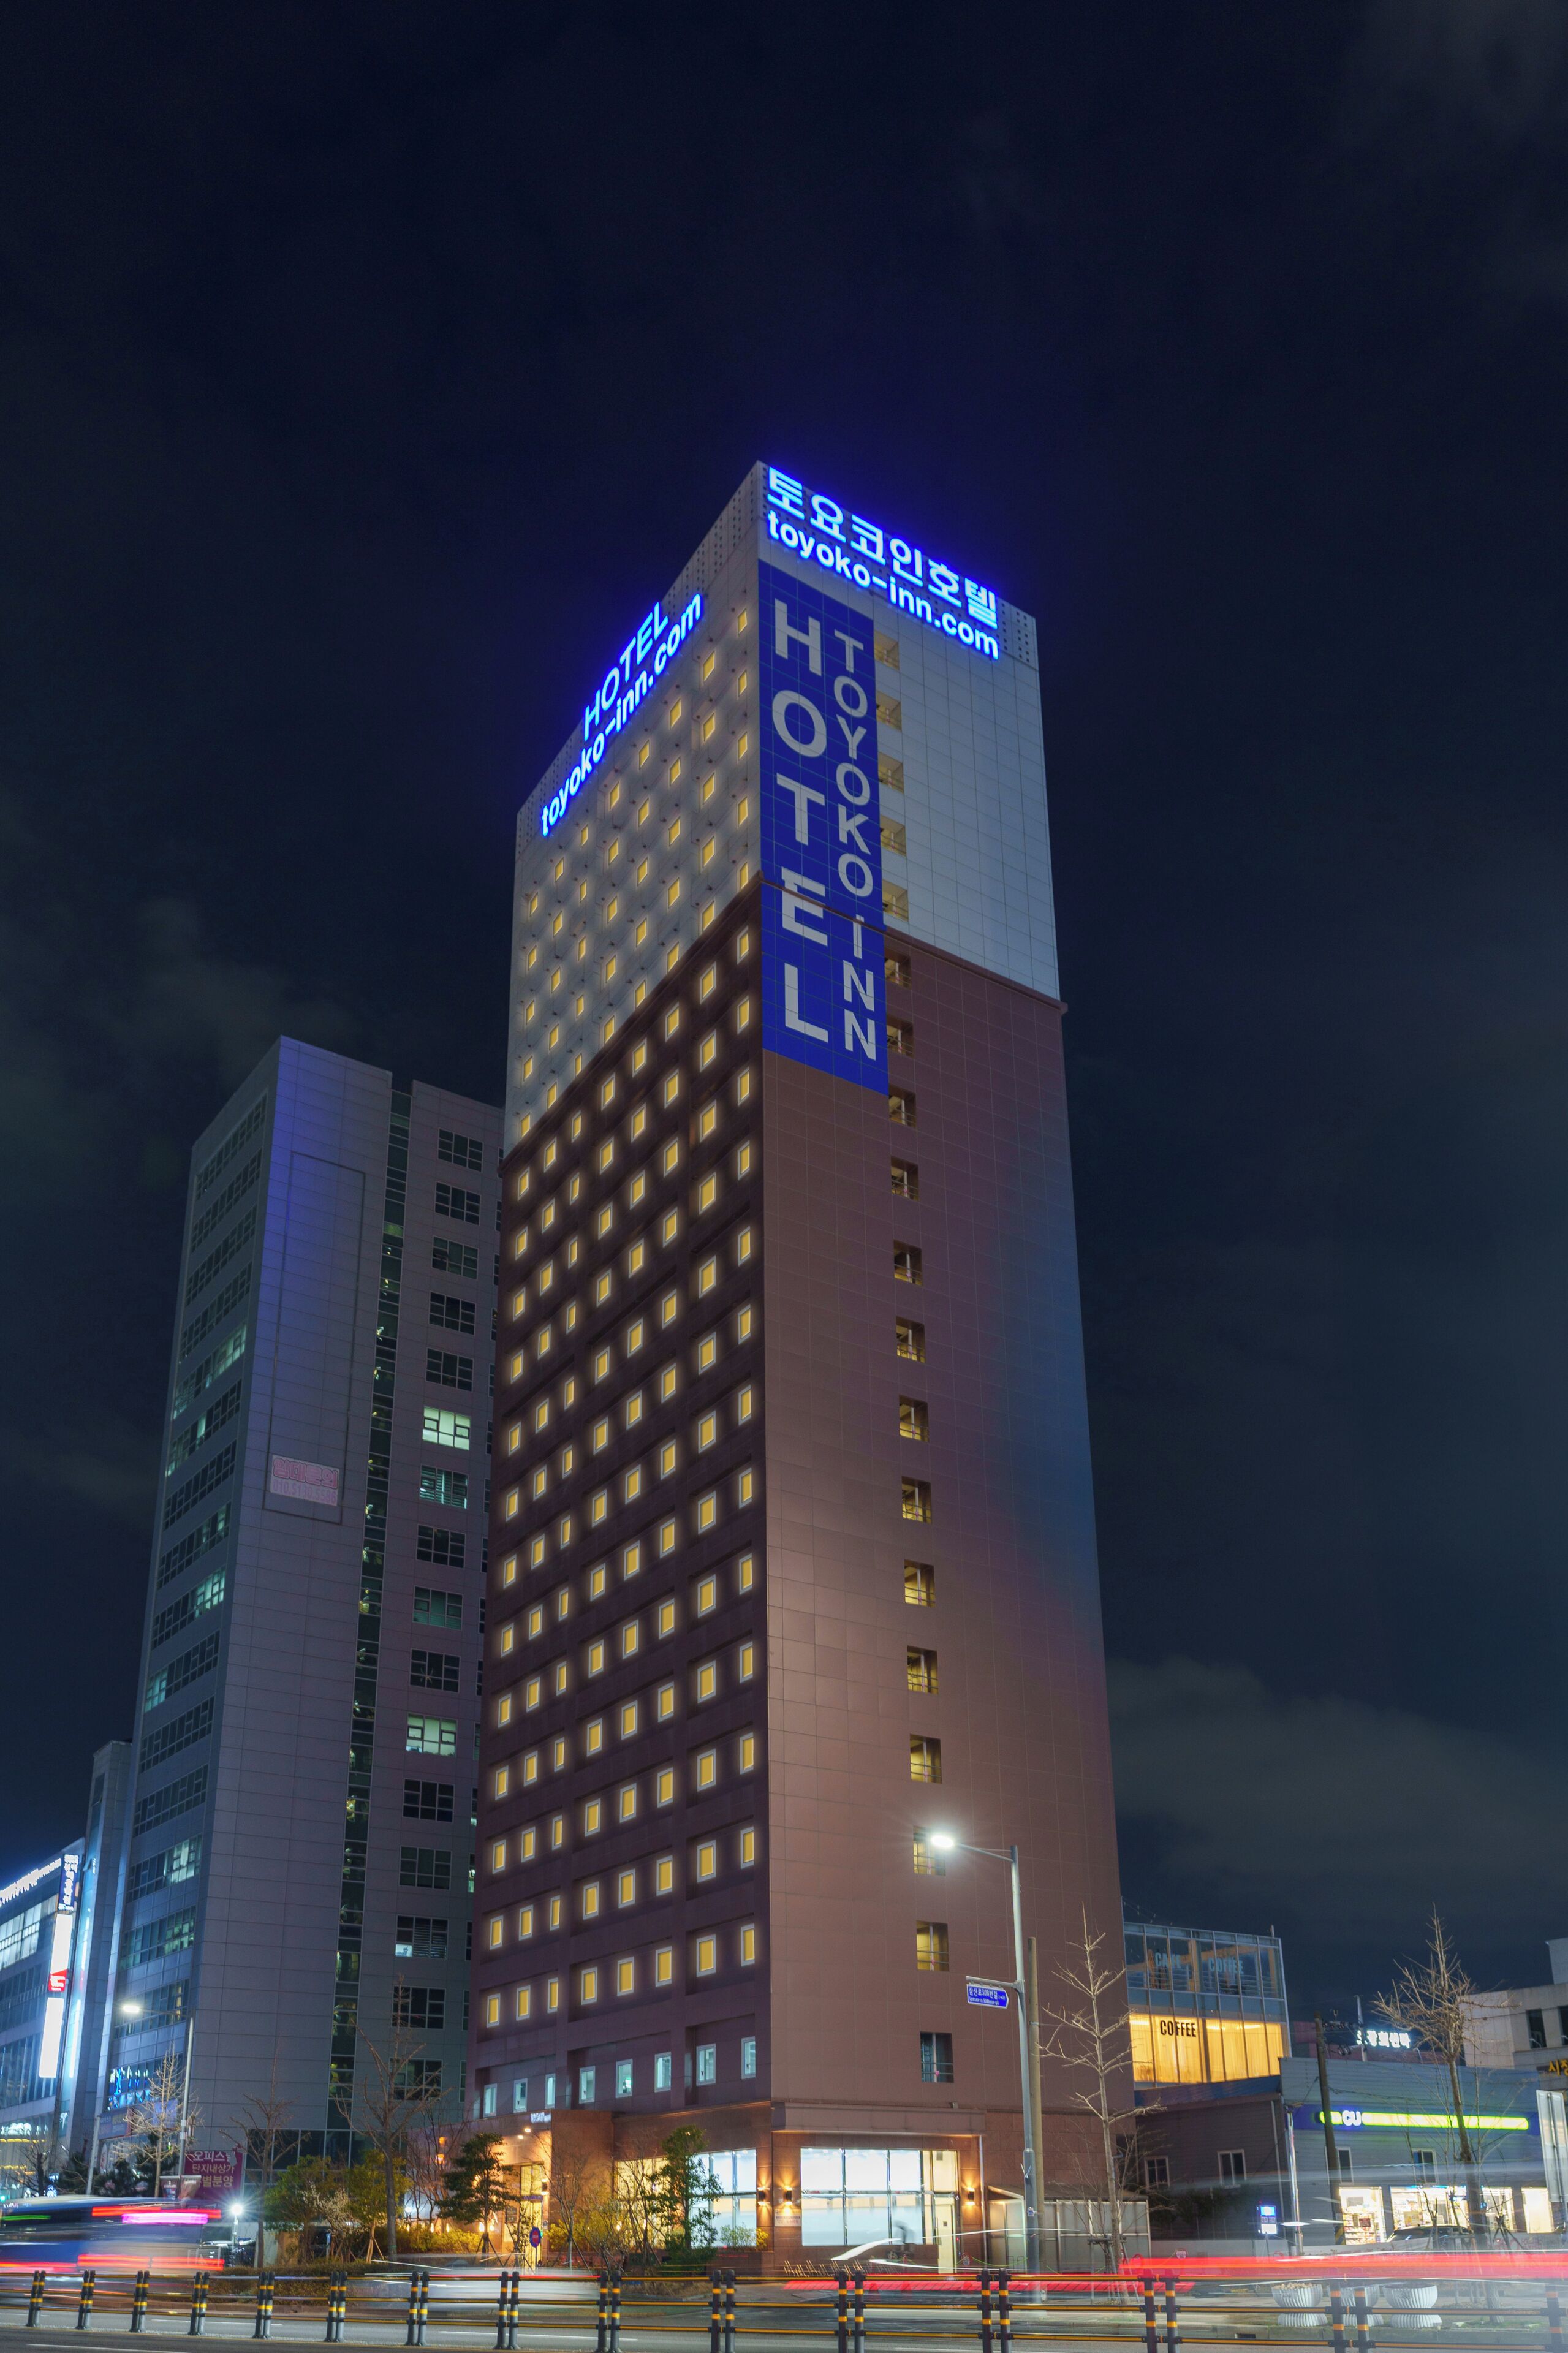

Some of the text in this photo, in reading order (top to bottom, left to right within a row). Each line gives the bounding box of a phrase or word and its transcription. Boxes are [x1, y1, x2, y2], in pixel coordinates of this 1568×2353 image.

[767, 466, 998, 629] 토요코인호텔
[767, 510, 999, 660] toyoko-inn.com
[584, 601, 668, 741] HOTEL
[541, 593, 702, 836] toyoko-inn.com
[772, 598, 828, 1043] HOTEL
[833, 629, 876, 1061] TOYOKO INN
[273, 1458, 338, 1489] 임대문의
[969, 1987, 998, 1999] 삼산로308번길
[1160, 2020, 1197, 2037] COFFEE
[1342, 2110, 1362, 2127] CU
[192, 2163, 235, 2174] 단지내상가
[199, 2175, 234, 2188] 별분양
